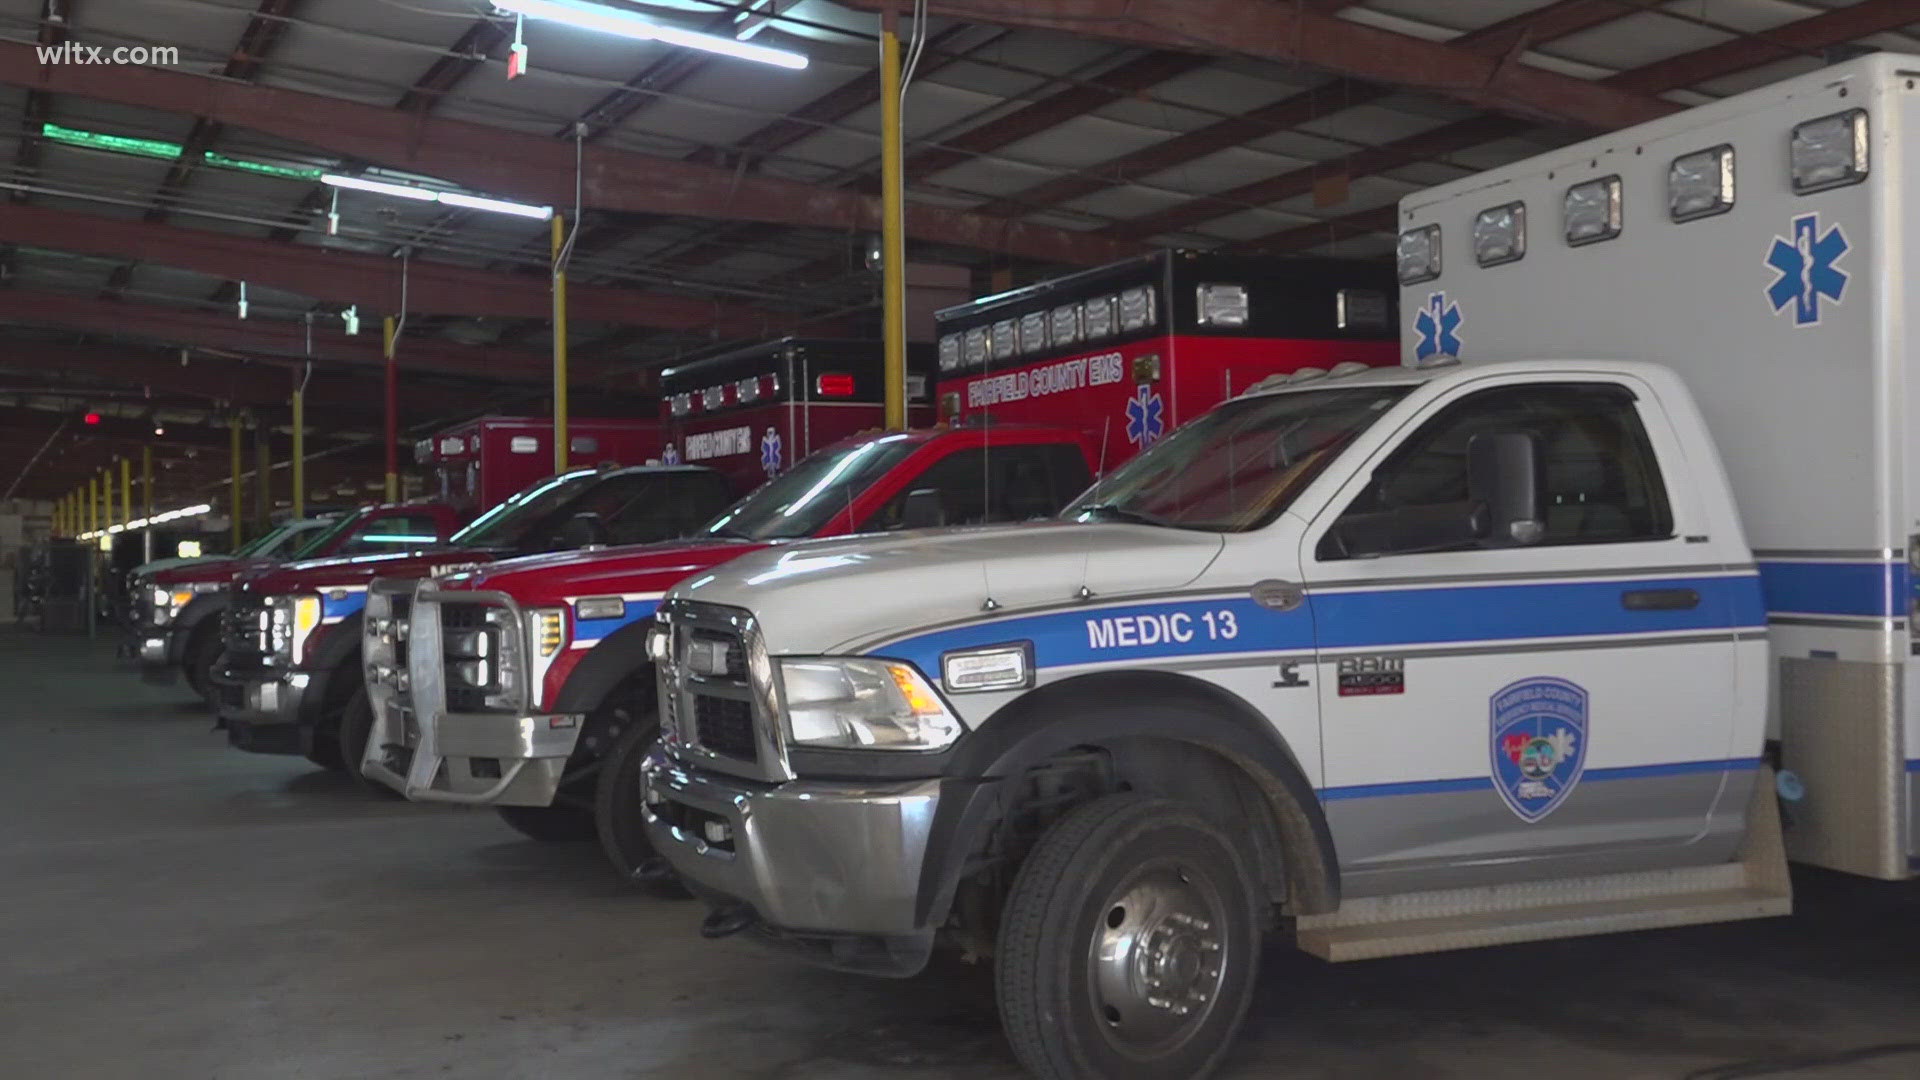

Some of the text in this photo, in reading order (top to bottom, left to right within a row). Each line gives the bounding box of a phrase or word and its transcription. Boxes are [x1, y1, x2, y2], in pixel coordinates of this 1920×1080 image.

[968, 352, 1123, 408] FAIRFIELD COUNTY EMS
[1086, 610, 1238, 649] MEDIC 13
[1338, 655, 1404, 674] RAM
